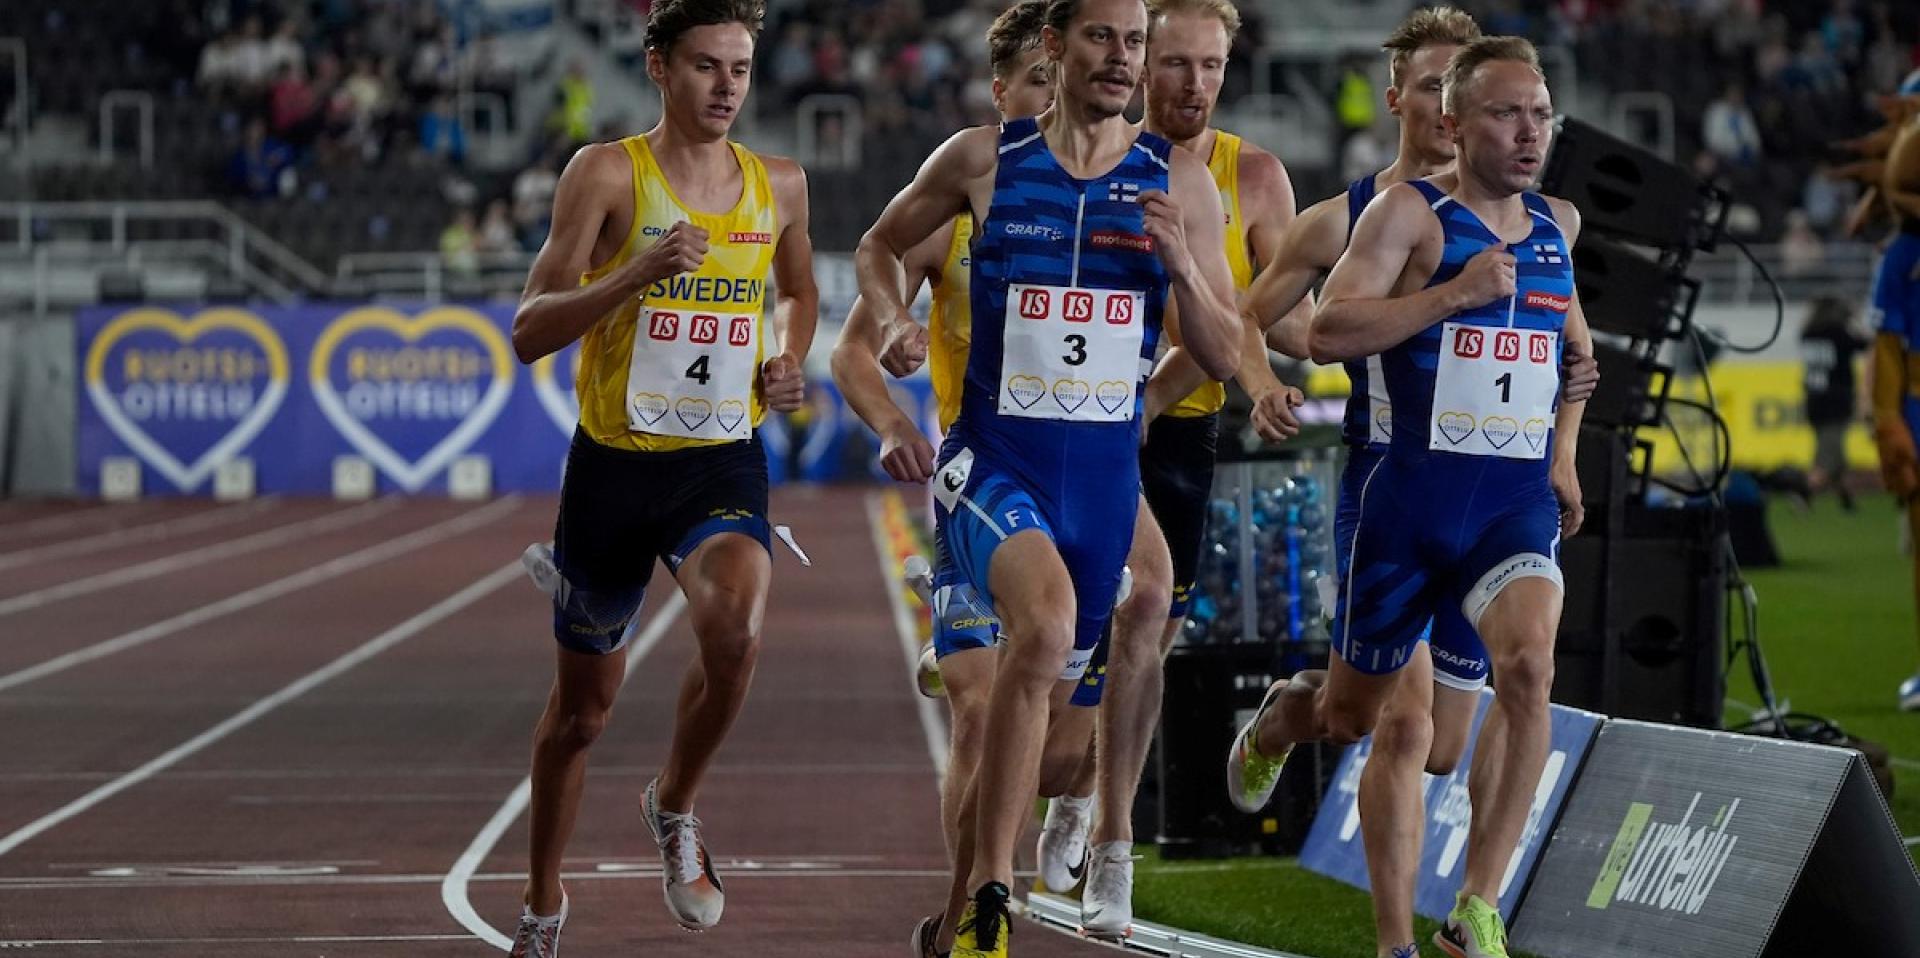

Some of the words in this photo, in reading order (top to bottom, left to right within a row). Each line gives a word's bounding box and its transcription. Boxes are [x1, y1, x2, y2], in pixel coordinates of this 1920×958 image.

[1005, 222, 1052, 237] CRAFT
[1092, 234, 1152, 252] motonet
[648, 275, 764, 302] SWEDEN
[1021, 291, 1049, 317] IS
[1065, 294, 1092, 320] IS
[1108, 297, 1131, 322] IS
[651, 314, 677, 339] IS
[690, 317, 716, 341] IS
[729, 319, 749, 345] IS
[1061, 334, 1088, 366] 3
[1457, 331, 1482, 356] IS
[1495, 334, 1518, 358] IS
[1530, 336, 1547, 361] IS
[685, 355, 711, 385] 4
[1495, 372, 1511, 403] 1
[1004, 508, 1041, 529] FI
[1486, 559, 1533, 592] CRAFT
[1351, 639, 1407, 671] FIN
[1615, 791, 1741, 915] urheilu
